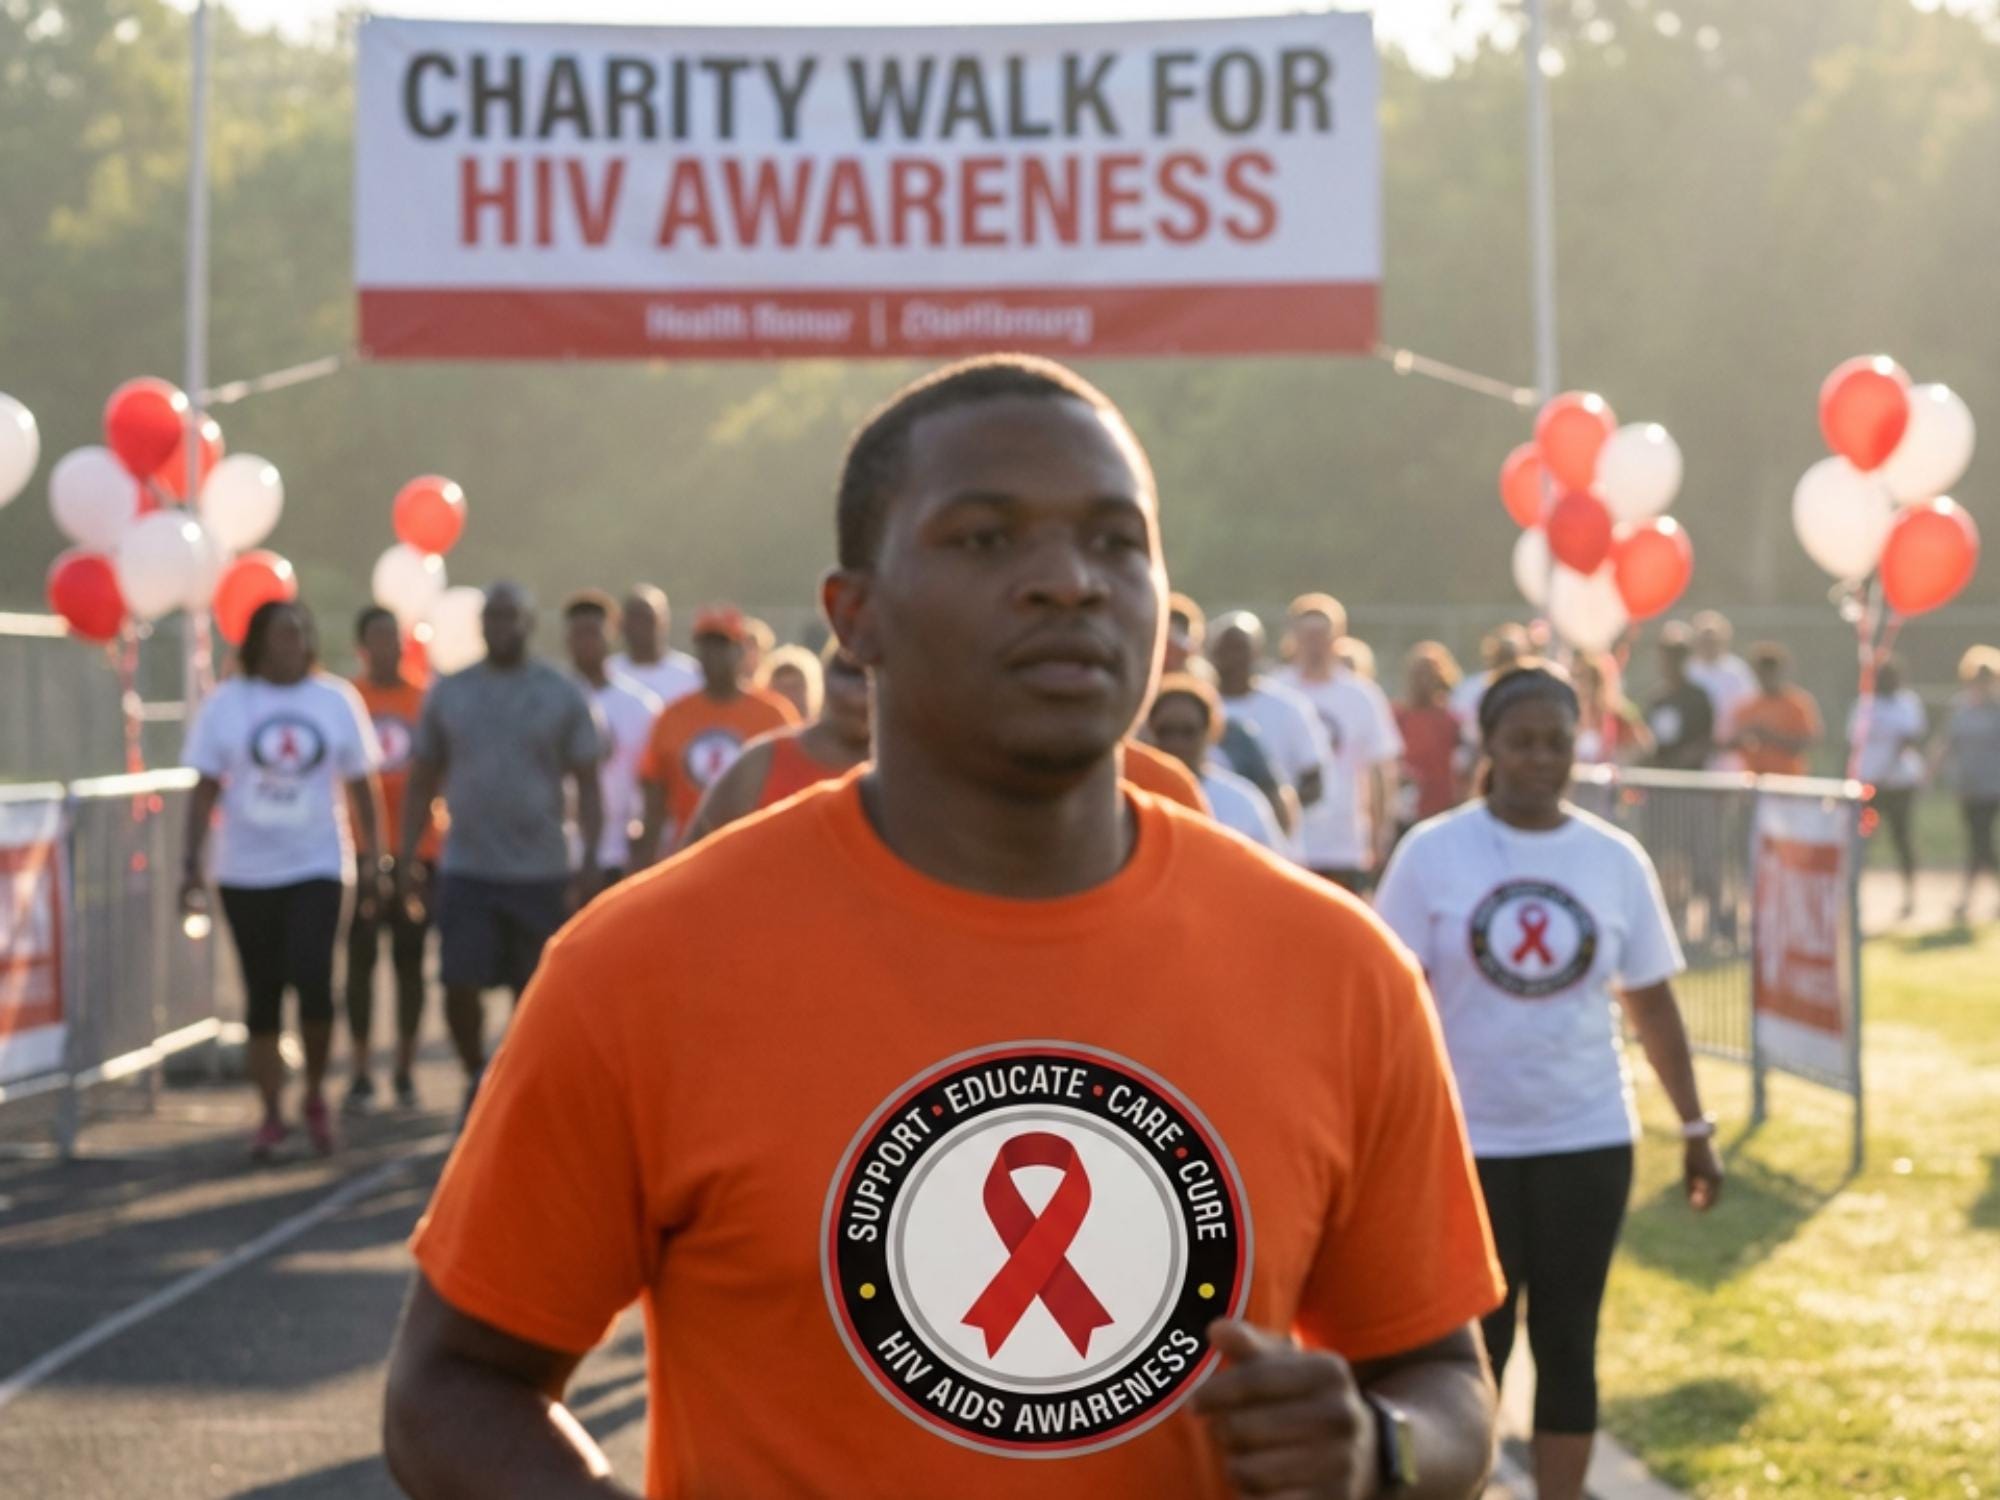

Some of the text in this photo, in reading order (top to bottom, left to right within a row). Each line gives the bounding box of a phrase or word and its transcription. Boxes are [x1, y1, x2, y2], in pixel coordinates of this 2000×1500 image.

[401, 48, 1333, 143] CHARITY WALK FOR
[460, 152, 1277, 249] HIV AWARENESS
[847, 1064, 1228, 1243] SUPPORT EDUCATE CARE CURE
[877, 1328, 1200, 1435] HIV AIDS AWARENESS
